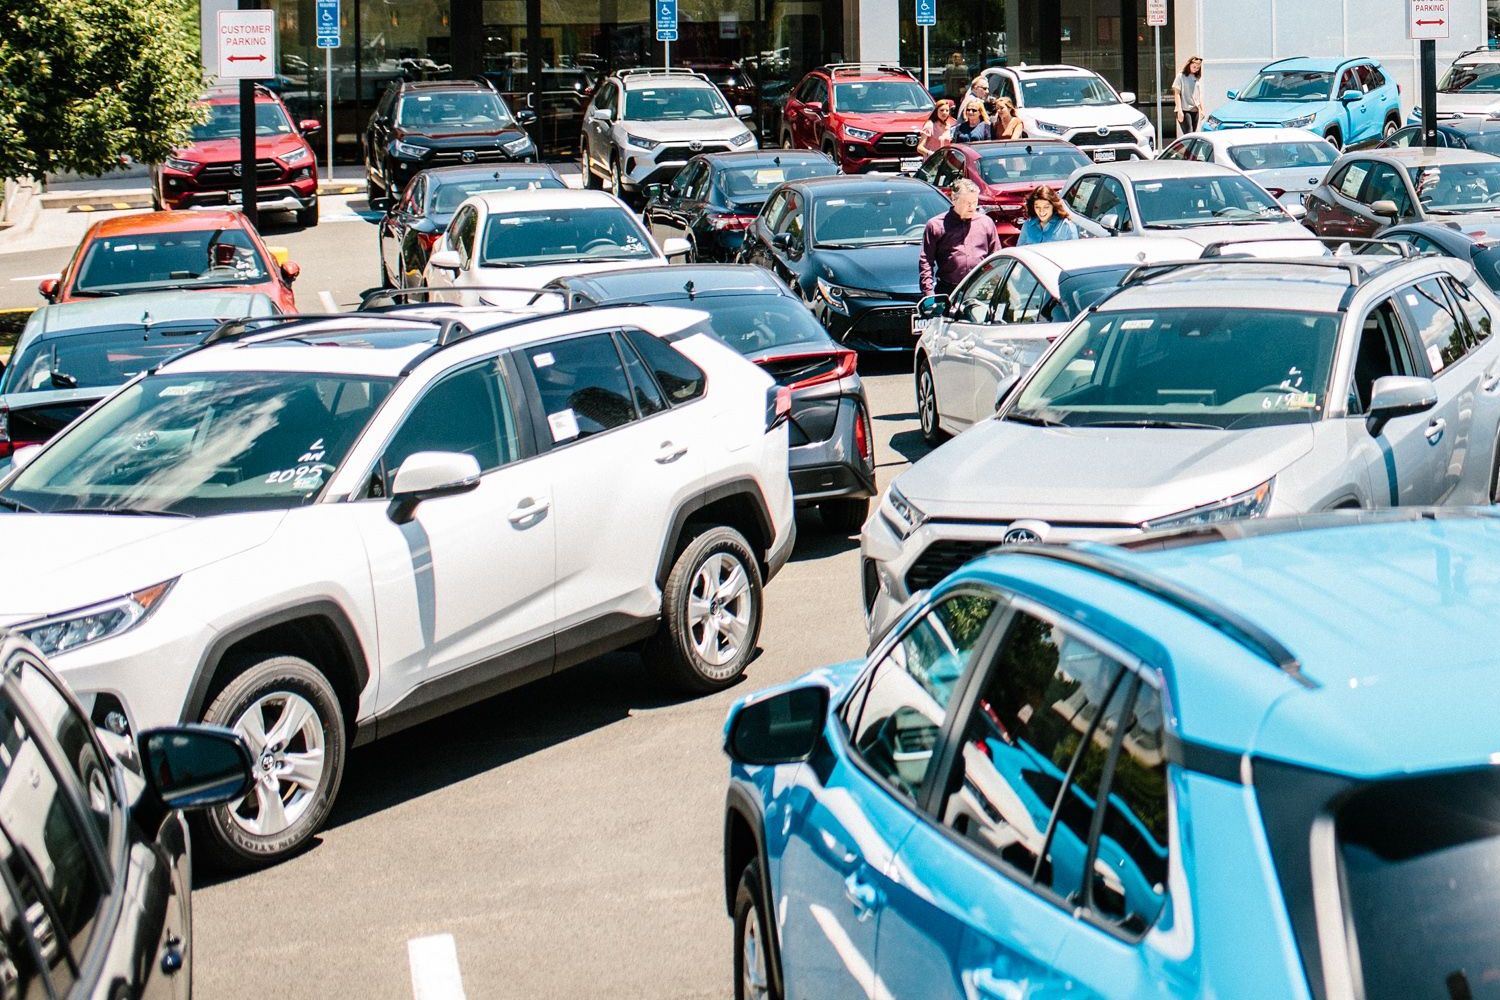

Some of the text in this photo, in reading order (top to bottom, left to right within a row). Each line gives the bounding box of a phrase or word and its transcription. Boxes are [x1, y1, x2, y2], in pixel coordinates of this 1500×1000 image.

[220, 25, 271, 34] CUSTOMER
[226, 37, 266, 46] PARKING
[265, 463, 326, 485] 2095
